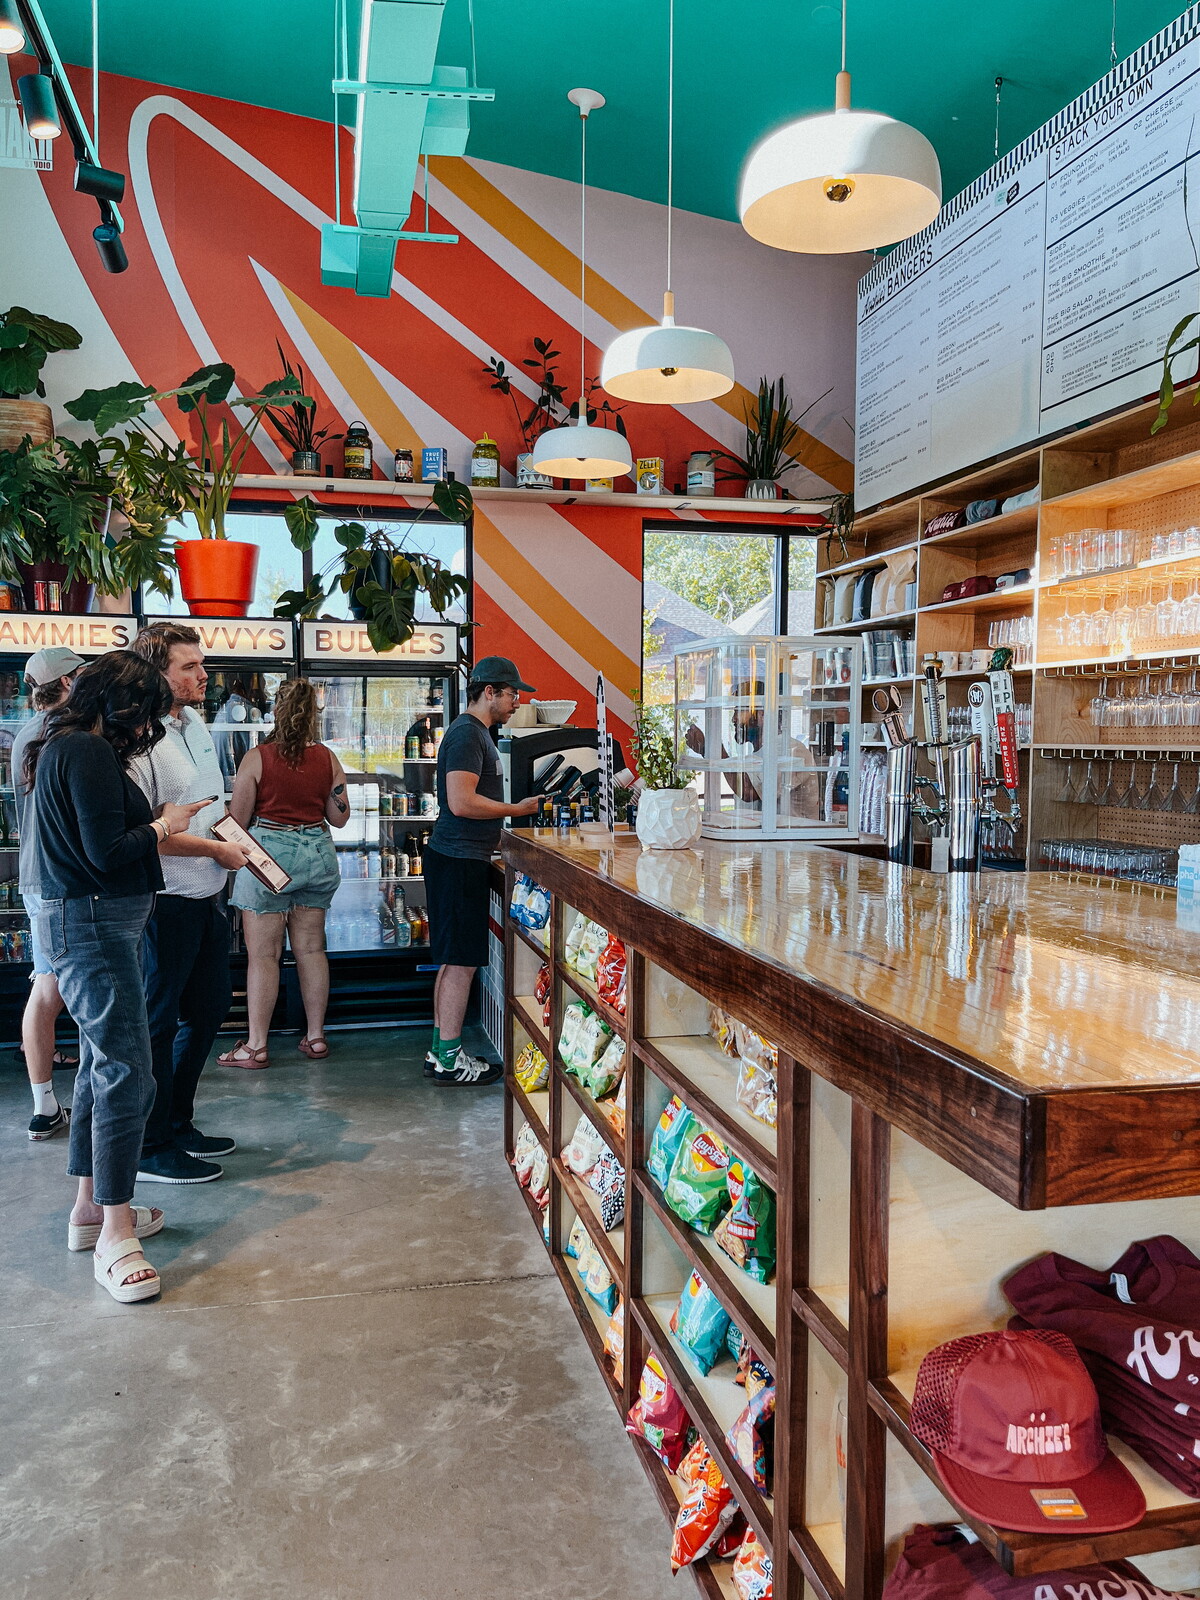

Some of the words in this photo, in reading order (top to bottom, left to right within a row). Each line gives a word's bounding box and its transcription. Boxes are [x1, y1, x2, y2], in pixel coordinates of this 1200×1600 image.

[1055, 123, 1088, 159] STACK
[1093, 98, 1123, 130] YOUR
[1128, 75, 1152, 105] OWN
[1145, 96, 1173, 121] CHEESE
[1060, 151, 1098, 181] FOUNDATION
[1059, 195, 1085, 216] VEGGIES
[1049, 241, 1066, 256] SIDES
[887, 244, 933, 296] BANGERS
[1048, 278, 1059, 289] THE
[1061, 272, 1071, 282] BIG
[1073, 252, 1105, 275] SMOOTHIE
[1047, 312, 1058, 322] THE
[1060, 306, 1070, 316] BIG
[1072, 294, 1092, 310] SALAD
[0, 621, 130, 648] AMMIES
[192, 626, 287, 651] VVYS
[315, 630, 446, 655] BUDES
[1002, 746, 1012, 783] BELGIUM
[754, 1363, 770, 1378] SIETE
[1006, 1423, 1072, 1455] ARCHIE'S
